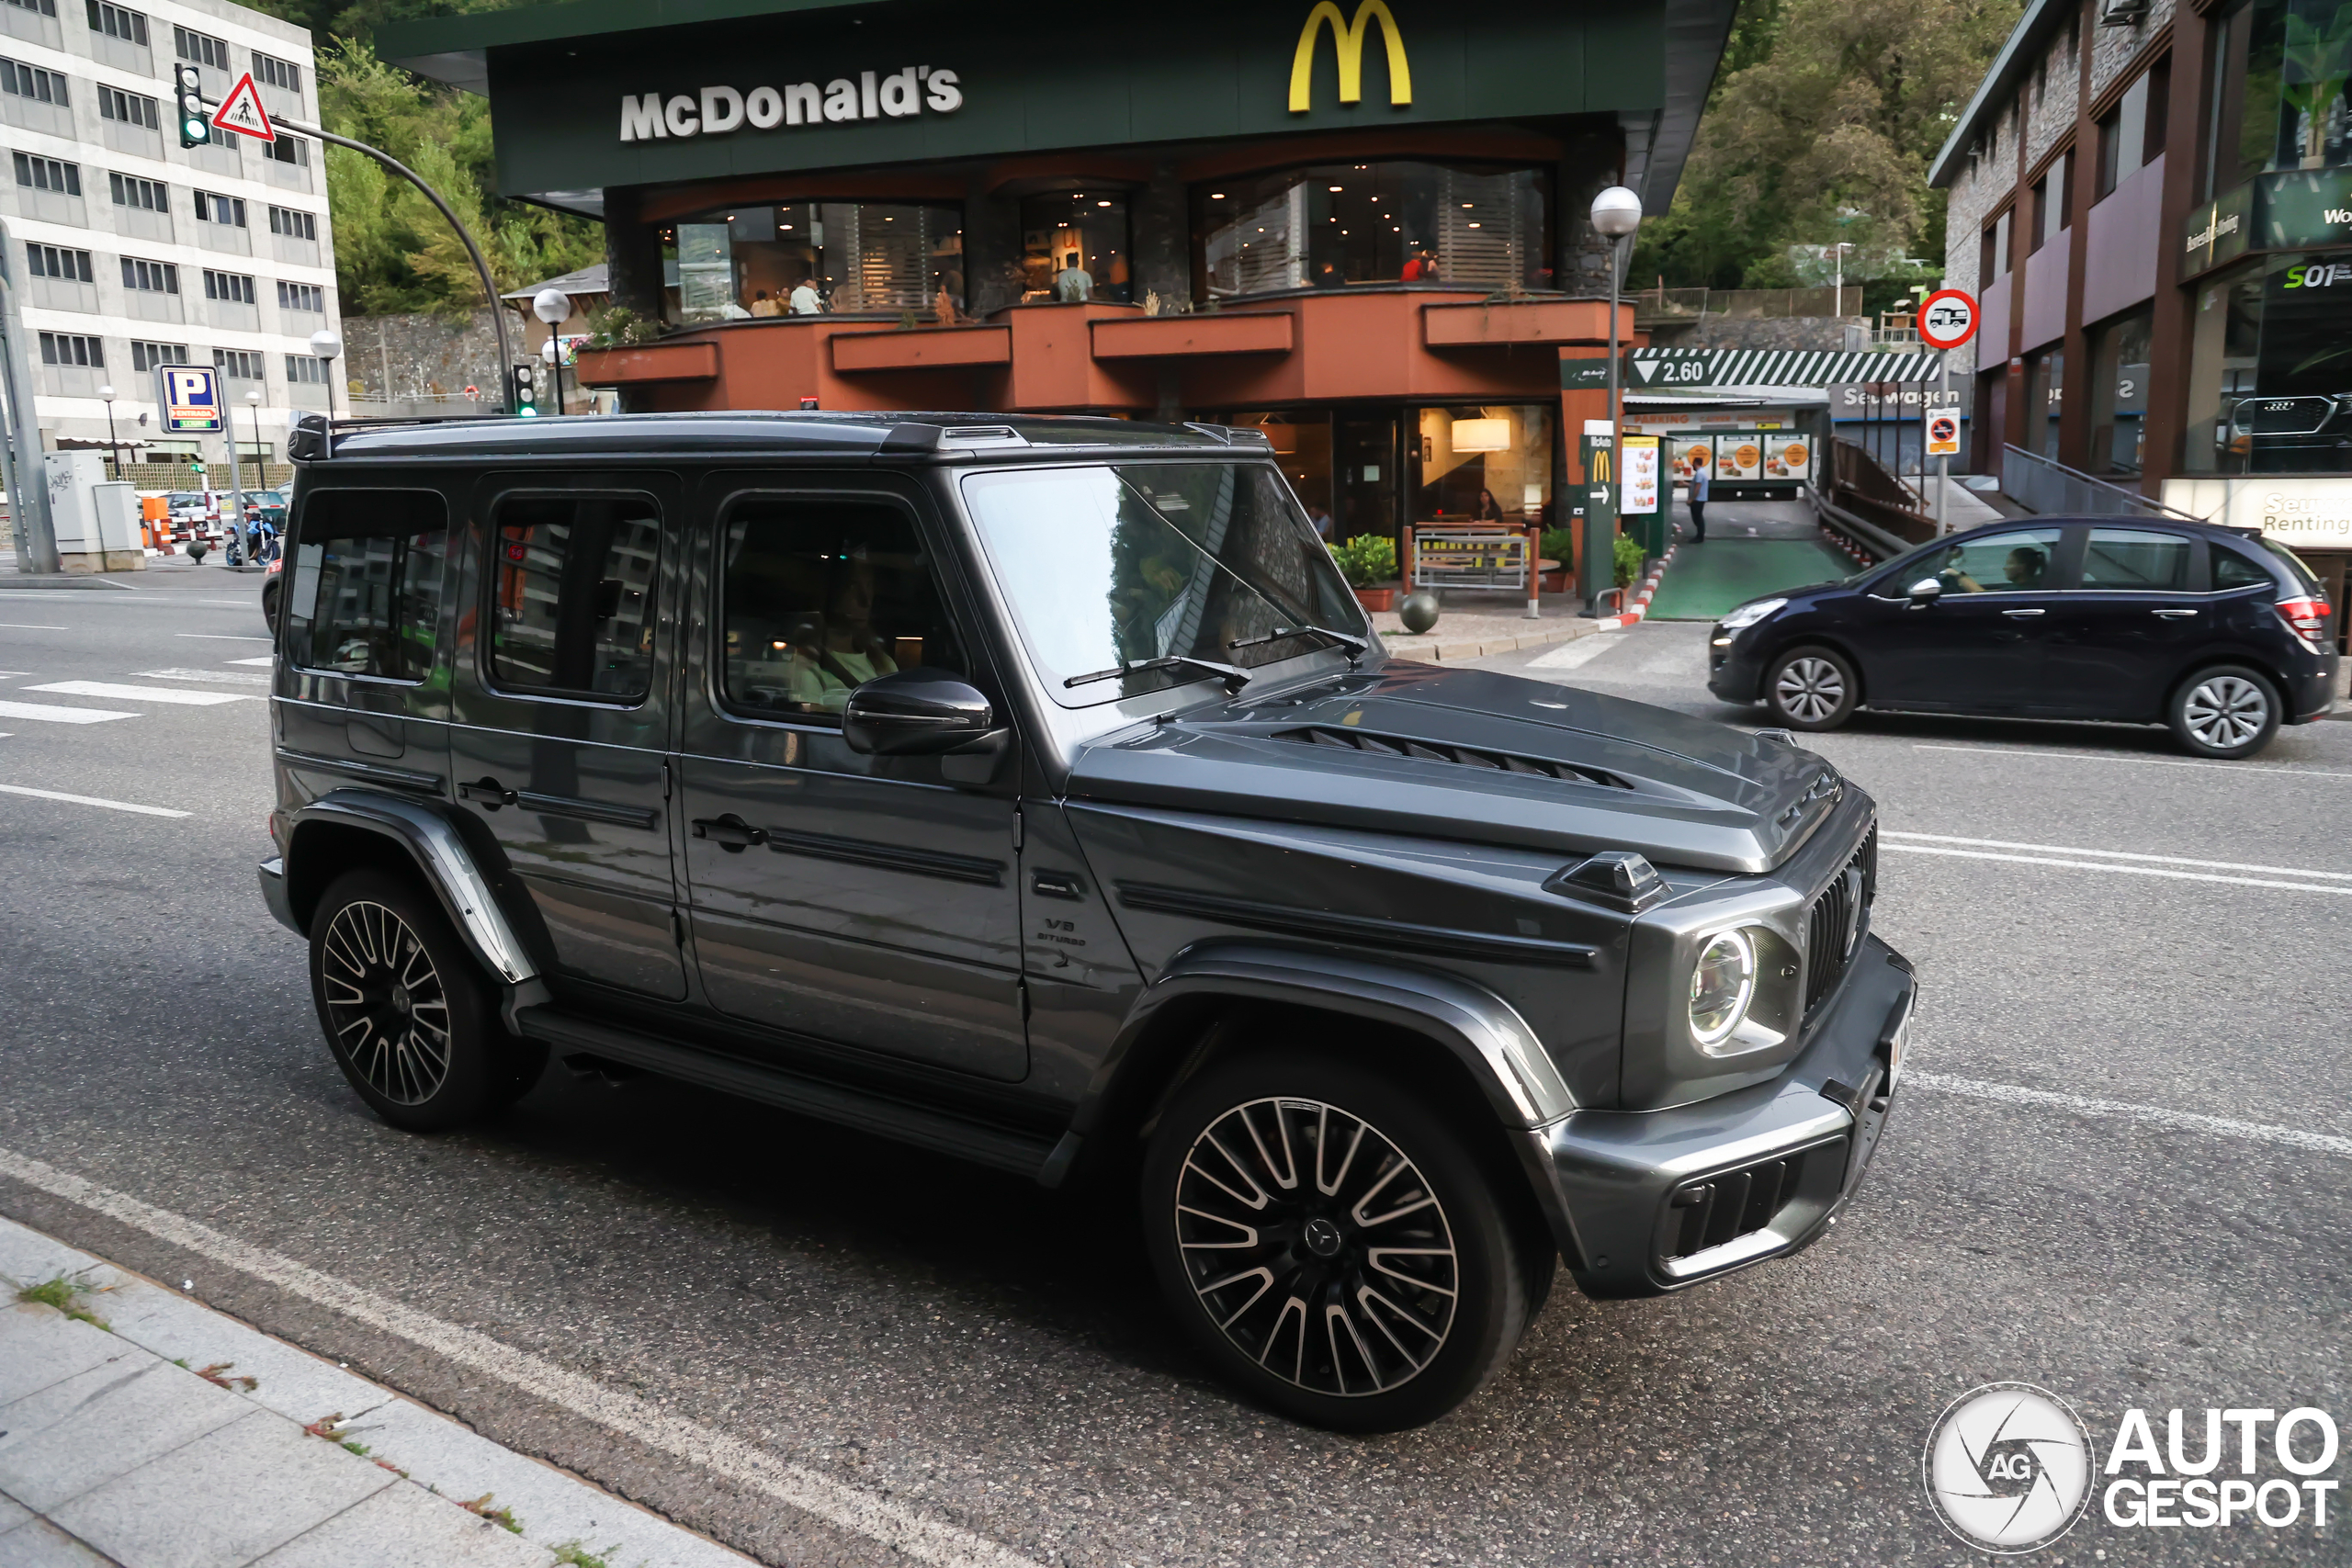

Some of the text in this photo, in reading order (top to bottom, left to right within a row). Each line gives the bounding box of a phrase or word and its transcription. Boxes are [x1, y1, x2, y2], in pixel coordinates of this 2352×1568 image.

[620, 64, 963, 141] McDonald's
[2324, 208, 2352, 224] Wo
[2283, 264, 2336, 288] S01
[1663, 361, 1703, 382] 2.60
[173, 372, 207, 405] P
[1634, 414, 1690, 424] PARKING
[1590, 435, 1612, 447] McAuto
[2263, 515, 2350, 535] Renting
[1045, 918, 1075, 932] V8
[1037, 932, 1086, 947] BITURBO
